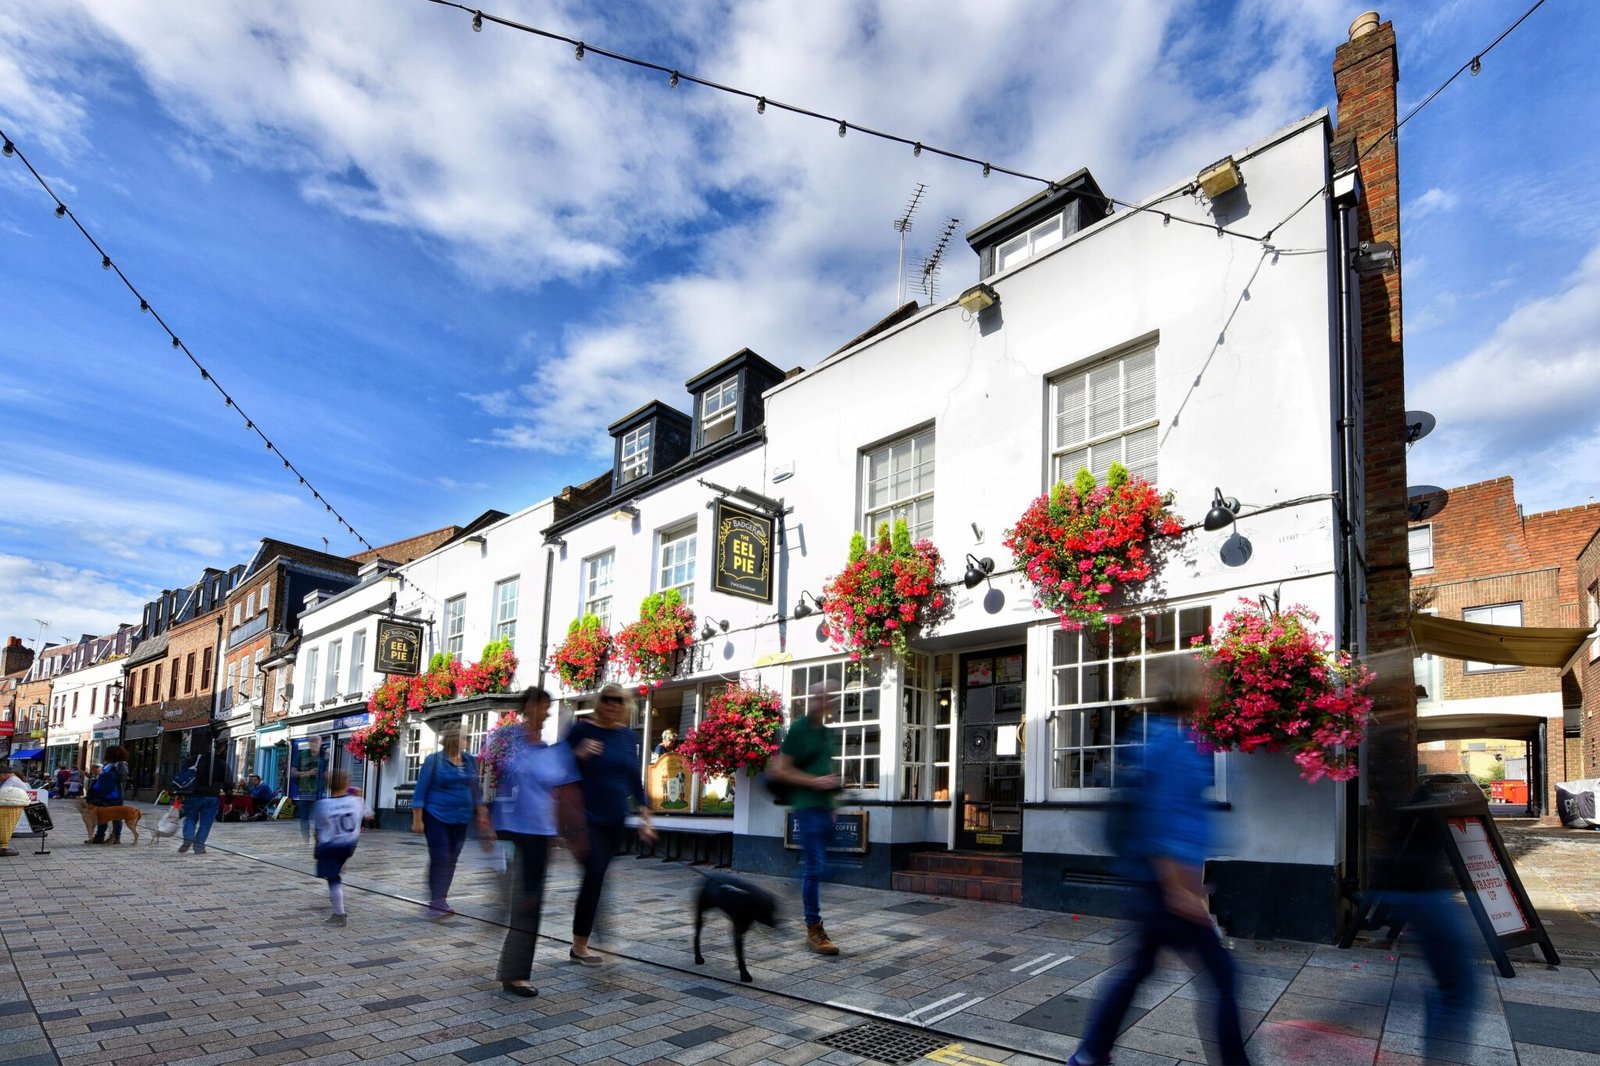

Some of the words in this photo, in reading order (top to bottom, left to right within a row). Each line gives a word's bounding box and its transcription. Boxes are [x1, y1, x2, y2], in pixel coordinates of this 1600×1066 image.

[733, 539, 755, 558] EEL
[733, 555, 754, 574] PIE
[391, 641, 408, 652] EEL
[391, 651, 407, 661] PIE
[671, 642, 714, 676] PIE
[329, 812, 356, 835] 10
[835, 824, 857, 832] COFFEE
[1488, 890, 1497, 900] UP
